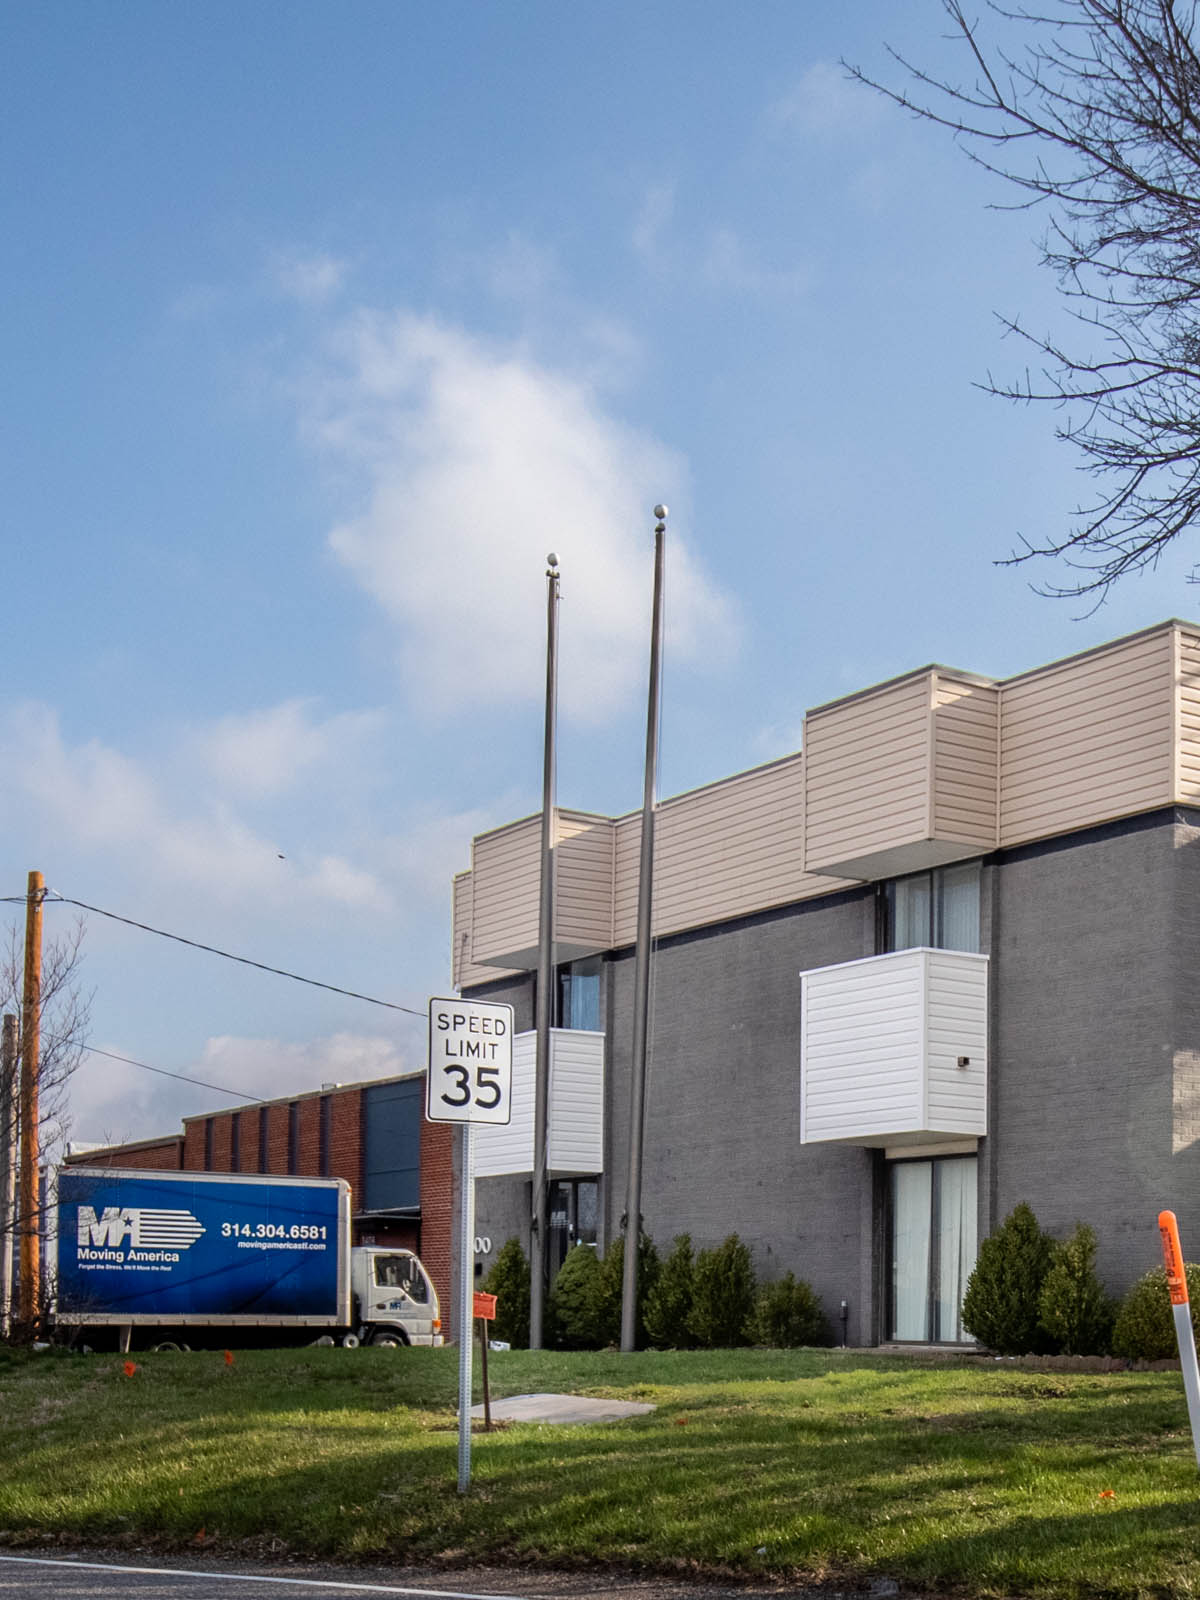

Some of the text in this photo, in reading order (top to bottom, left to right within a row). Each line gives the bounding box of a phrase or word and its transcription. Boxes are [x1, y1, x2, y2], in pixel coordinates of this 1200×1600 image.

[437, 1013, 506, 1036] SPEED
[445, 1038, 499, 1060] LIMIT
[440, 1064, 502, 1109] 35
[221, 1222, 327, 1240] 314.304.6581
[77, 1248, 180, 1262] Moving America
[237, 1240, 326, 1251] movingamericastl.com
